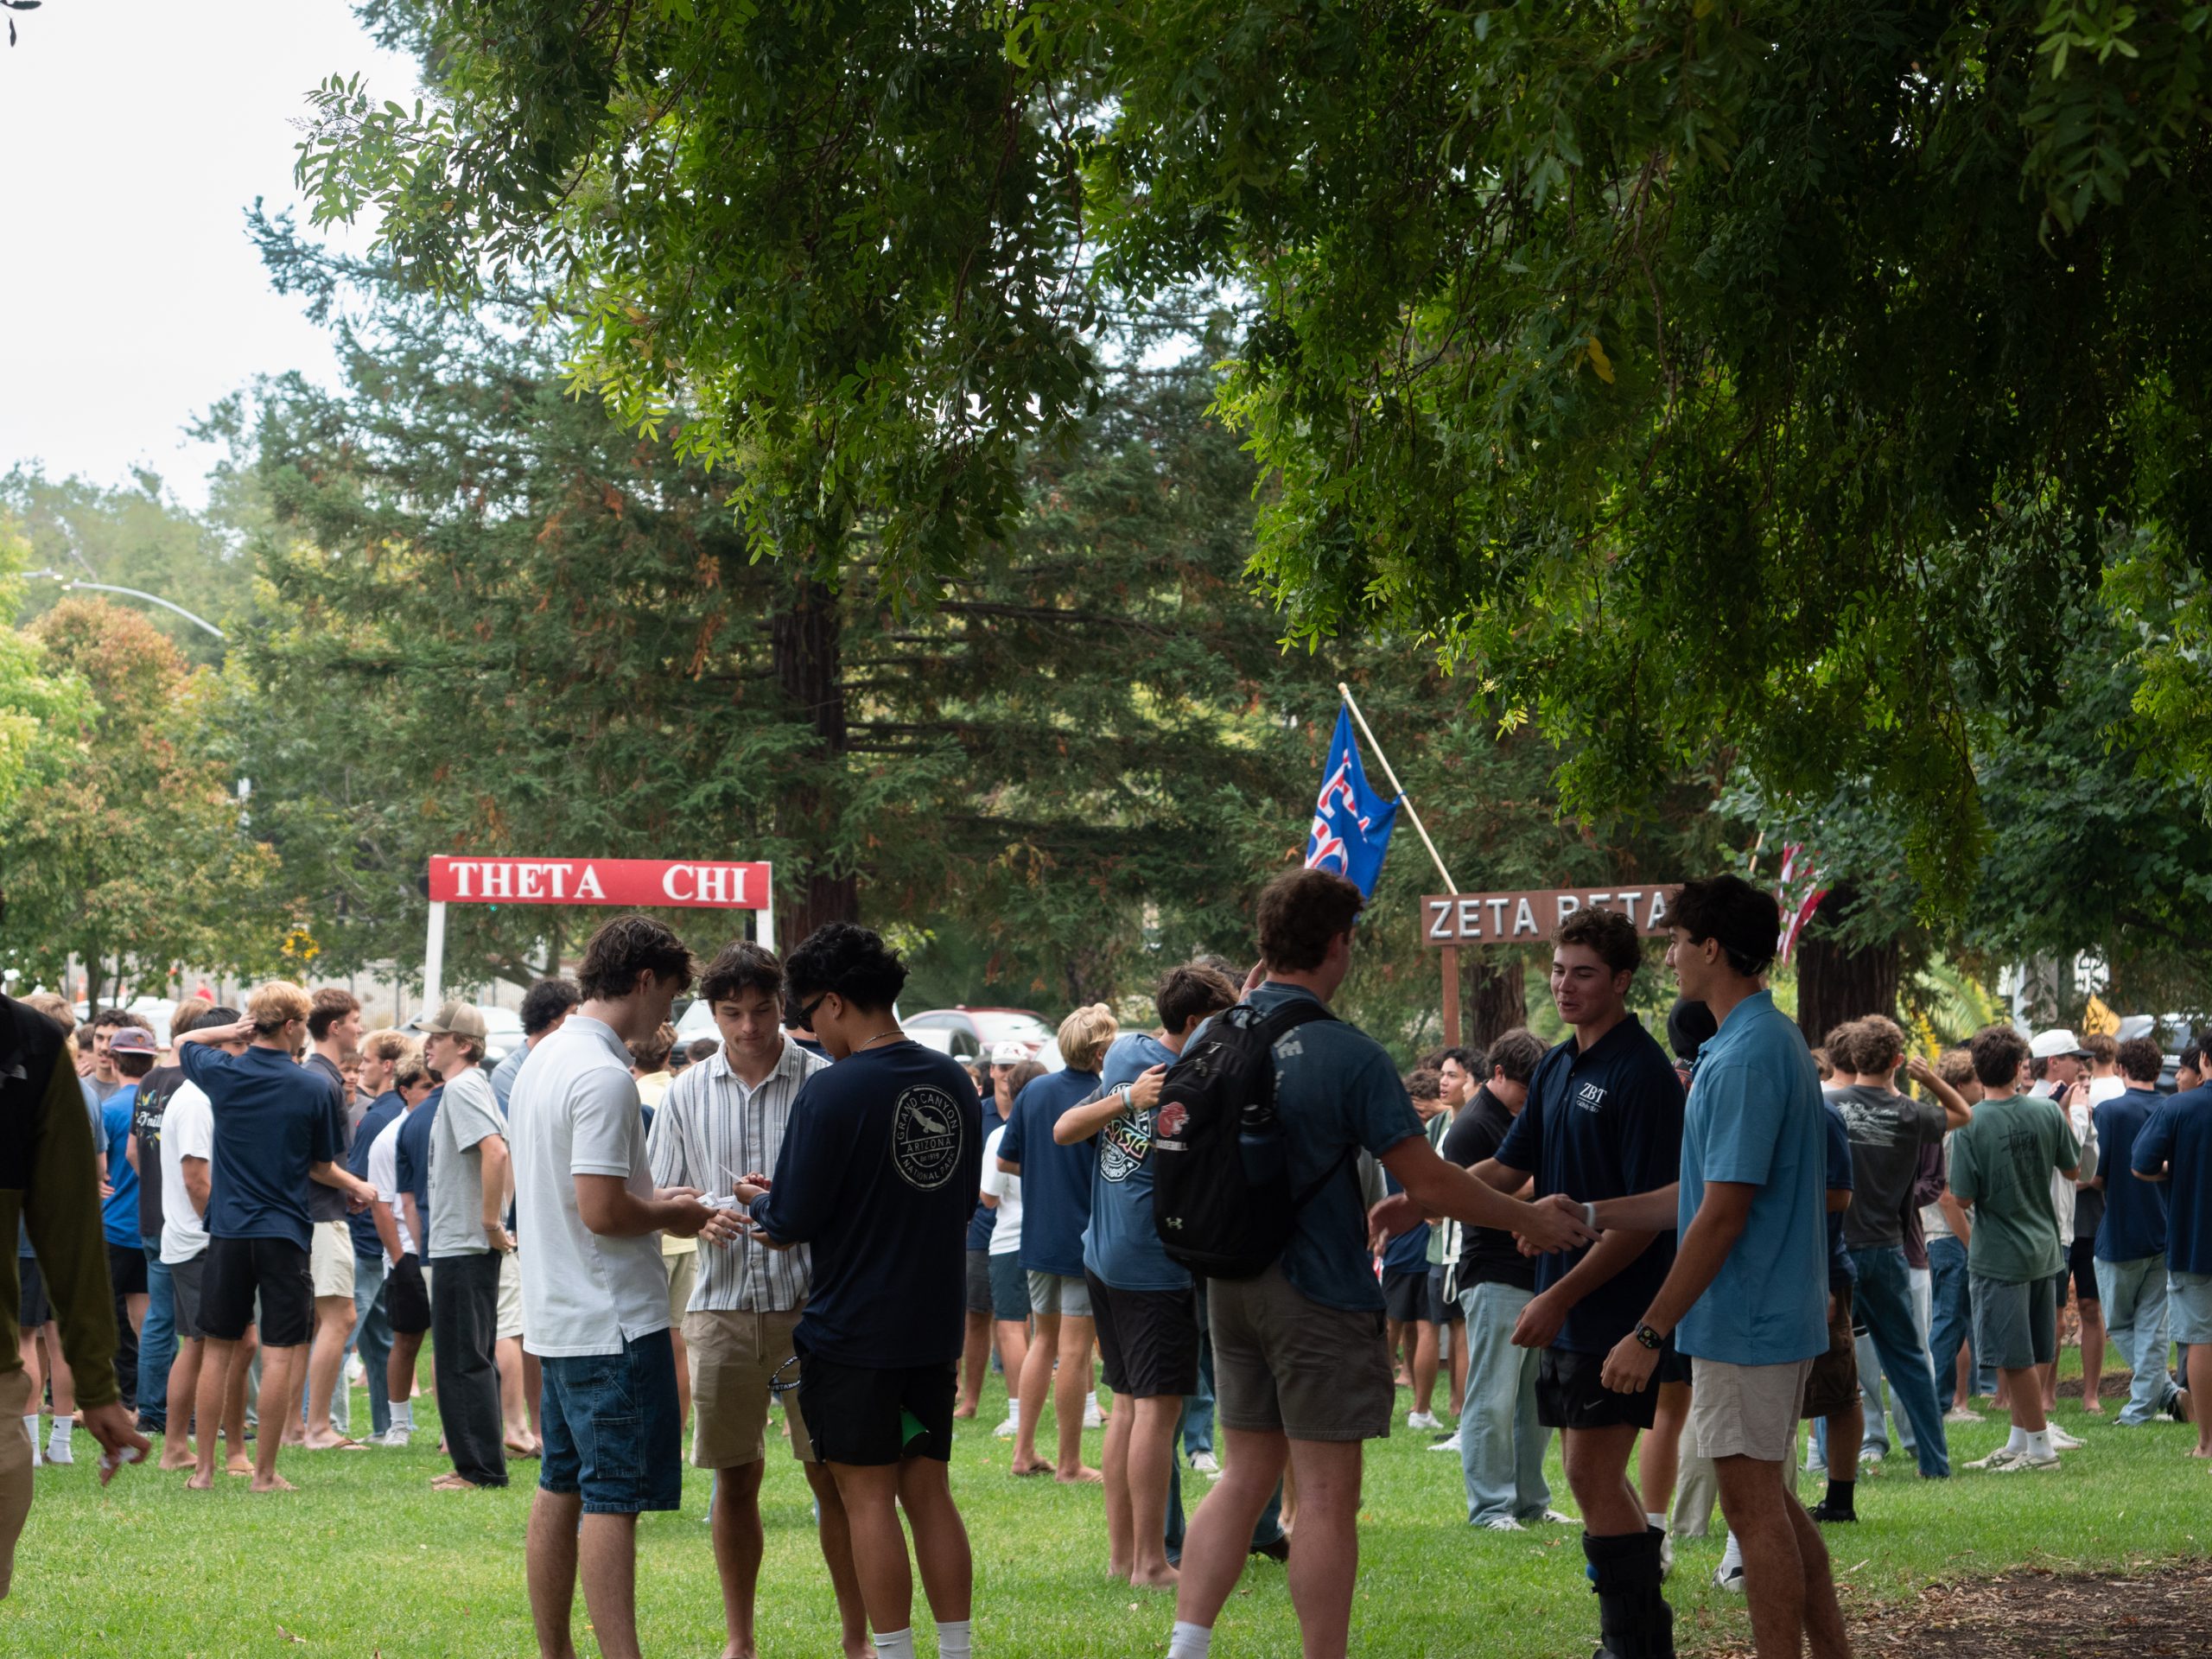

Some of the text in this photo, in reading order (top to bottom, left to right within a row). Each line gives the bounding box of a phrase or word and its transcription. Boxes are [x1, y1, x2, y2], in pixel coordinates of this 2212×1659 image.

[448, 861, 749, 904] THETA CHI
[1429, 898, 1539, 938] ZETA
[1579, 1082, 1608, 1103] ZBT
[897, 1093, 958, 1140] GRAND CANYON
[906, 1137, 951, 1154] ARIZONA
[902, 1153, 955, 1180] NATIONAL PARK
